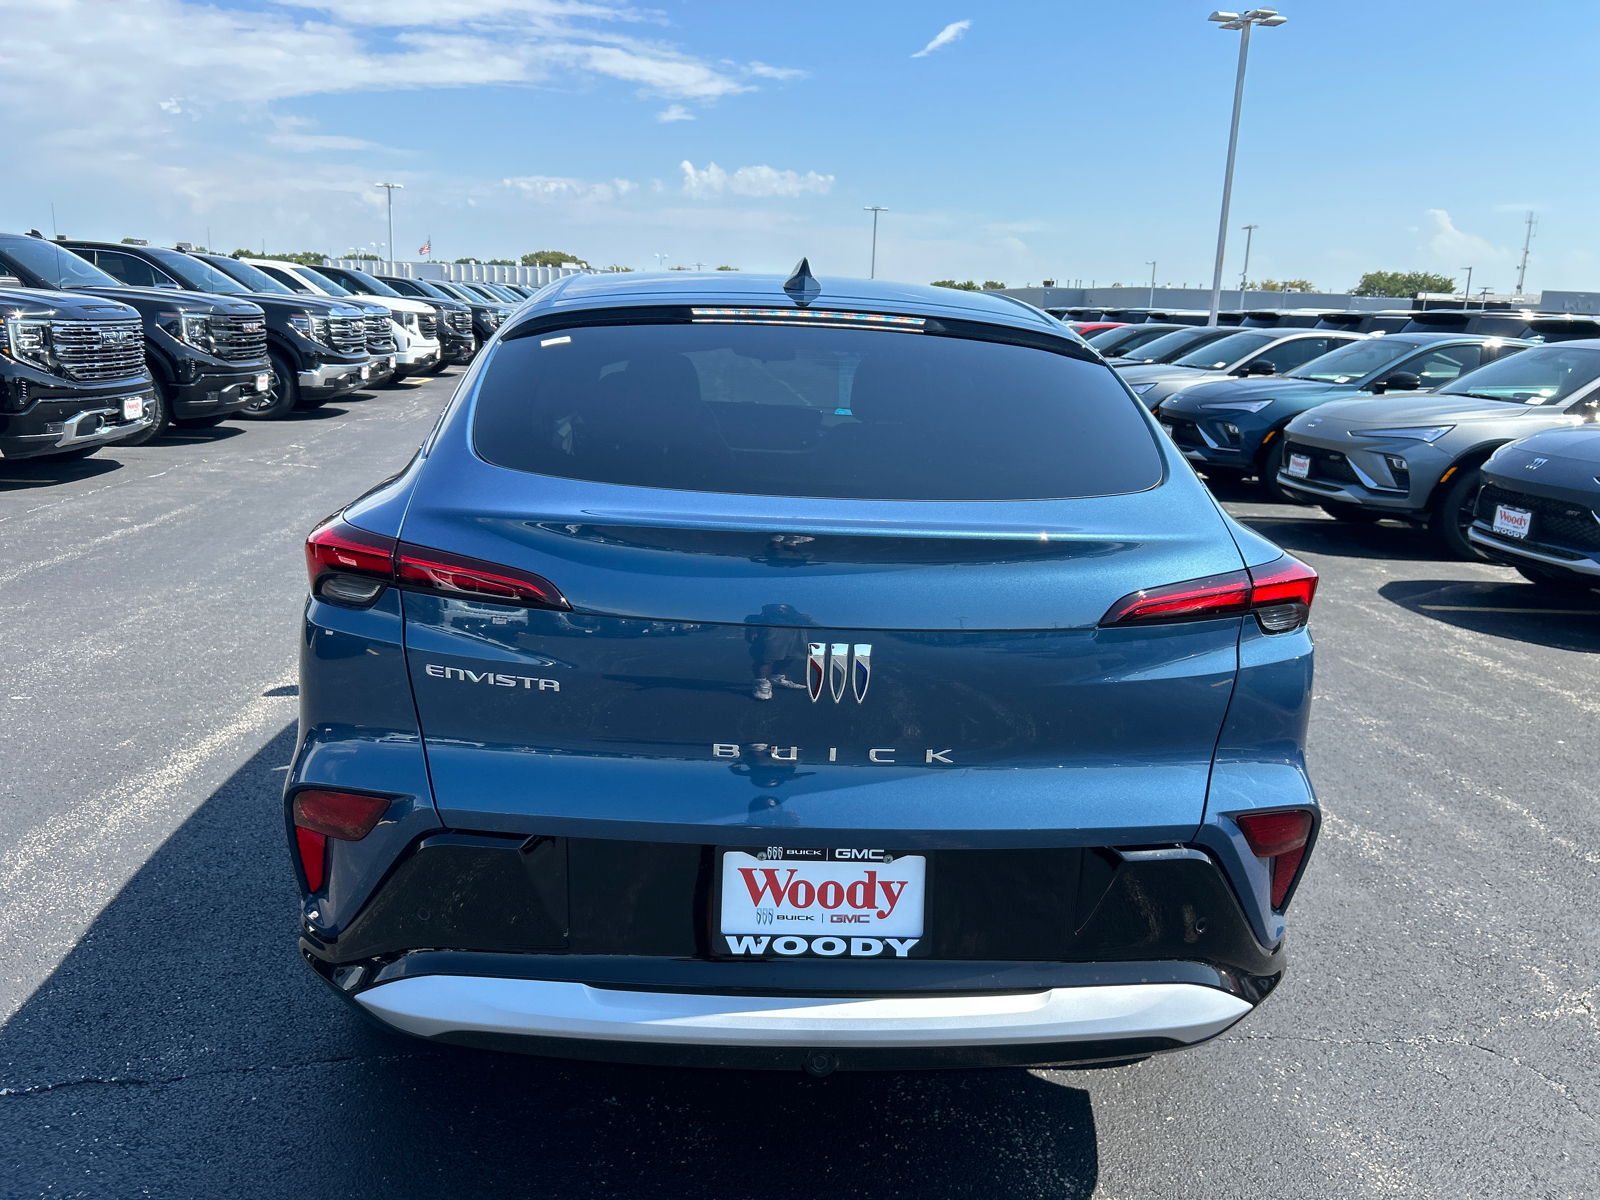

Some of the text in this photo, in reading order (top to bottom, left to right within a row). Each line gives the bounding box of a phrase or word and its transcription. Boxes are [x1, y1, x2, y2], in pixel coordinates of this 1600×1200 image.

[1499, 509, 1528, 529] Woody
[1493, 525, 1526, 540] WOODY
[425, 663, 561, 692] ENVISTA
[712, 743, 954, 764] BUICK
[835, 848, 885, 860] GMC
[737, 867, 909, 920] Woody
[830, 914, 870, 924] GMC
[724, 936, 920, 957] WOODY
